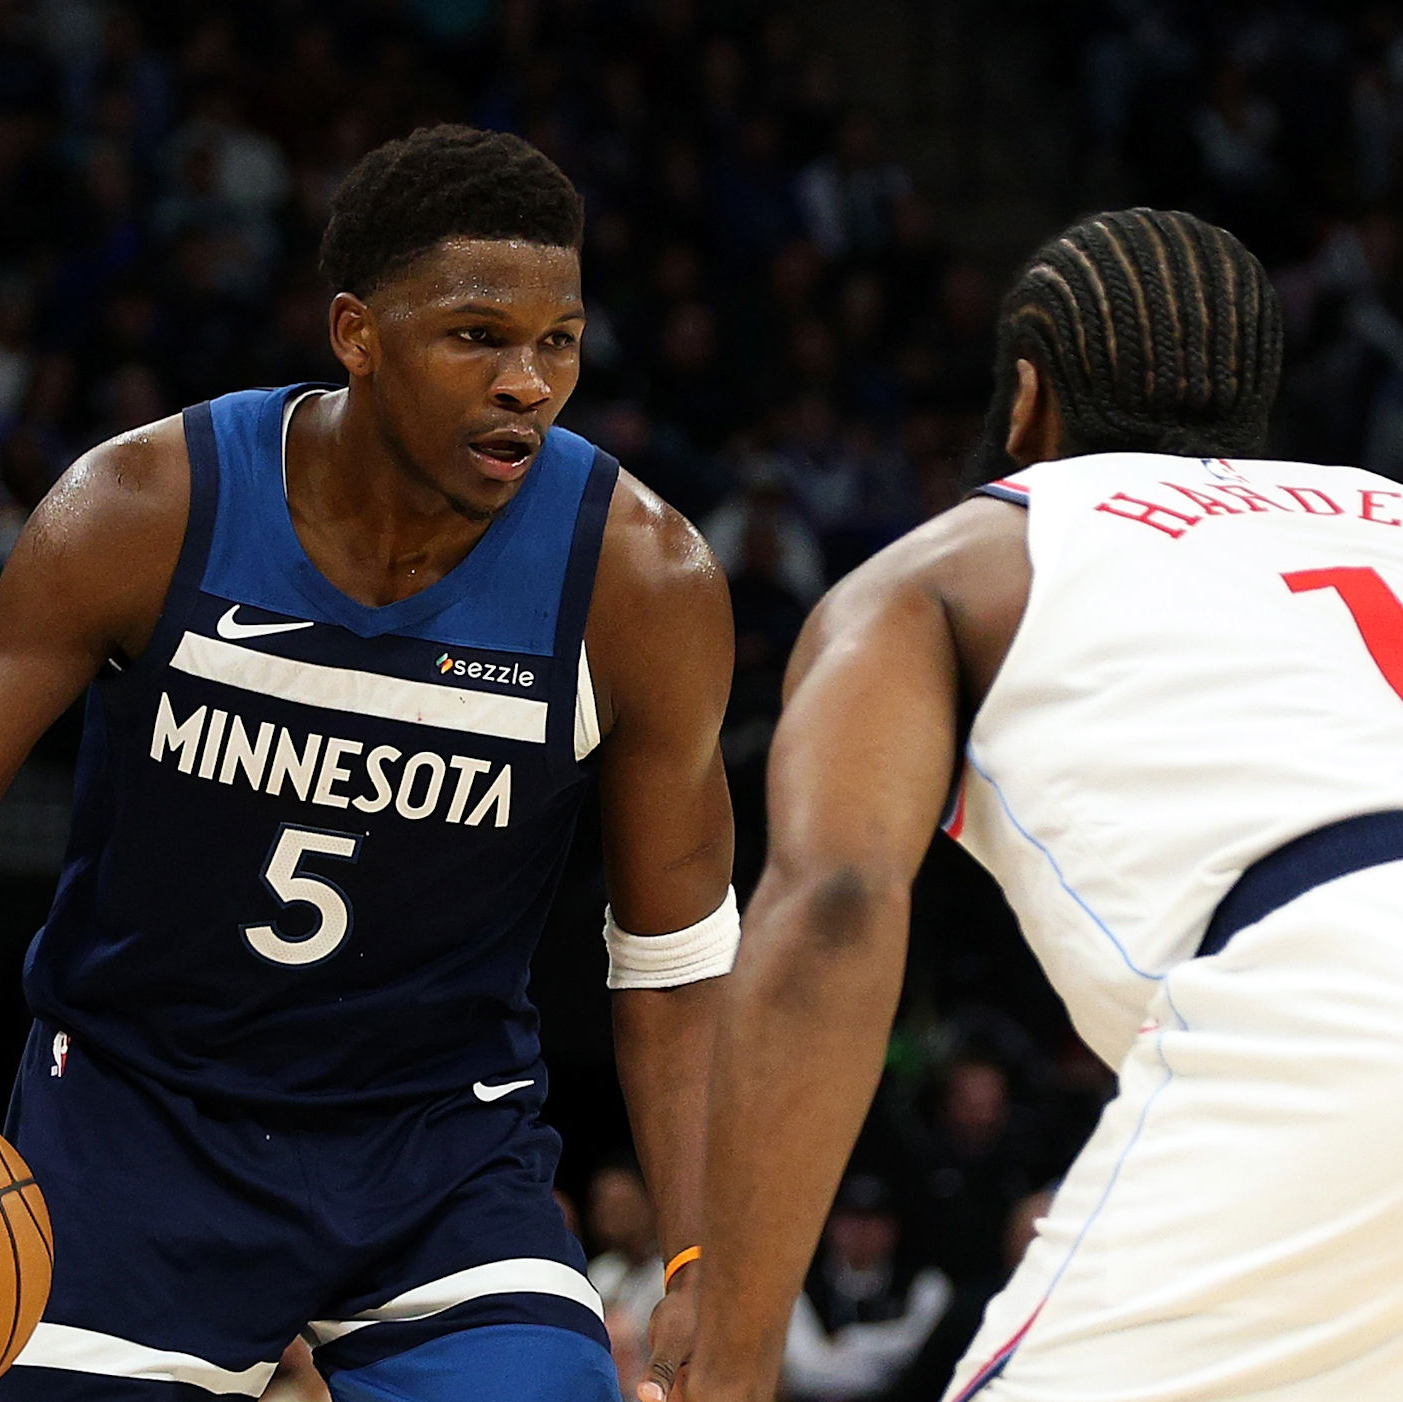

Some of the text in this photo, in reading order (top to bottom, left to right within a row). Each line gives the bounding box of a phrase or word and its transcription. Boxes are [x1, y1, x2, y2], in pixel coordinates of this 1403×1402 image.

[452, 657, 535, 688] sezzle
[149, 691, 512, 828] MINNESOTA
[241, 823, 362, 967] 5
